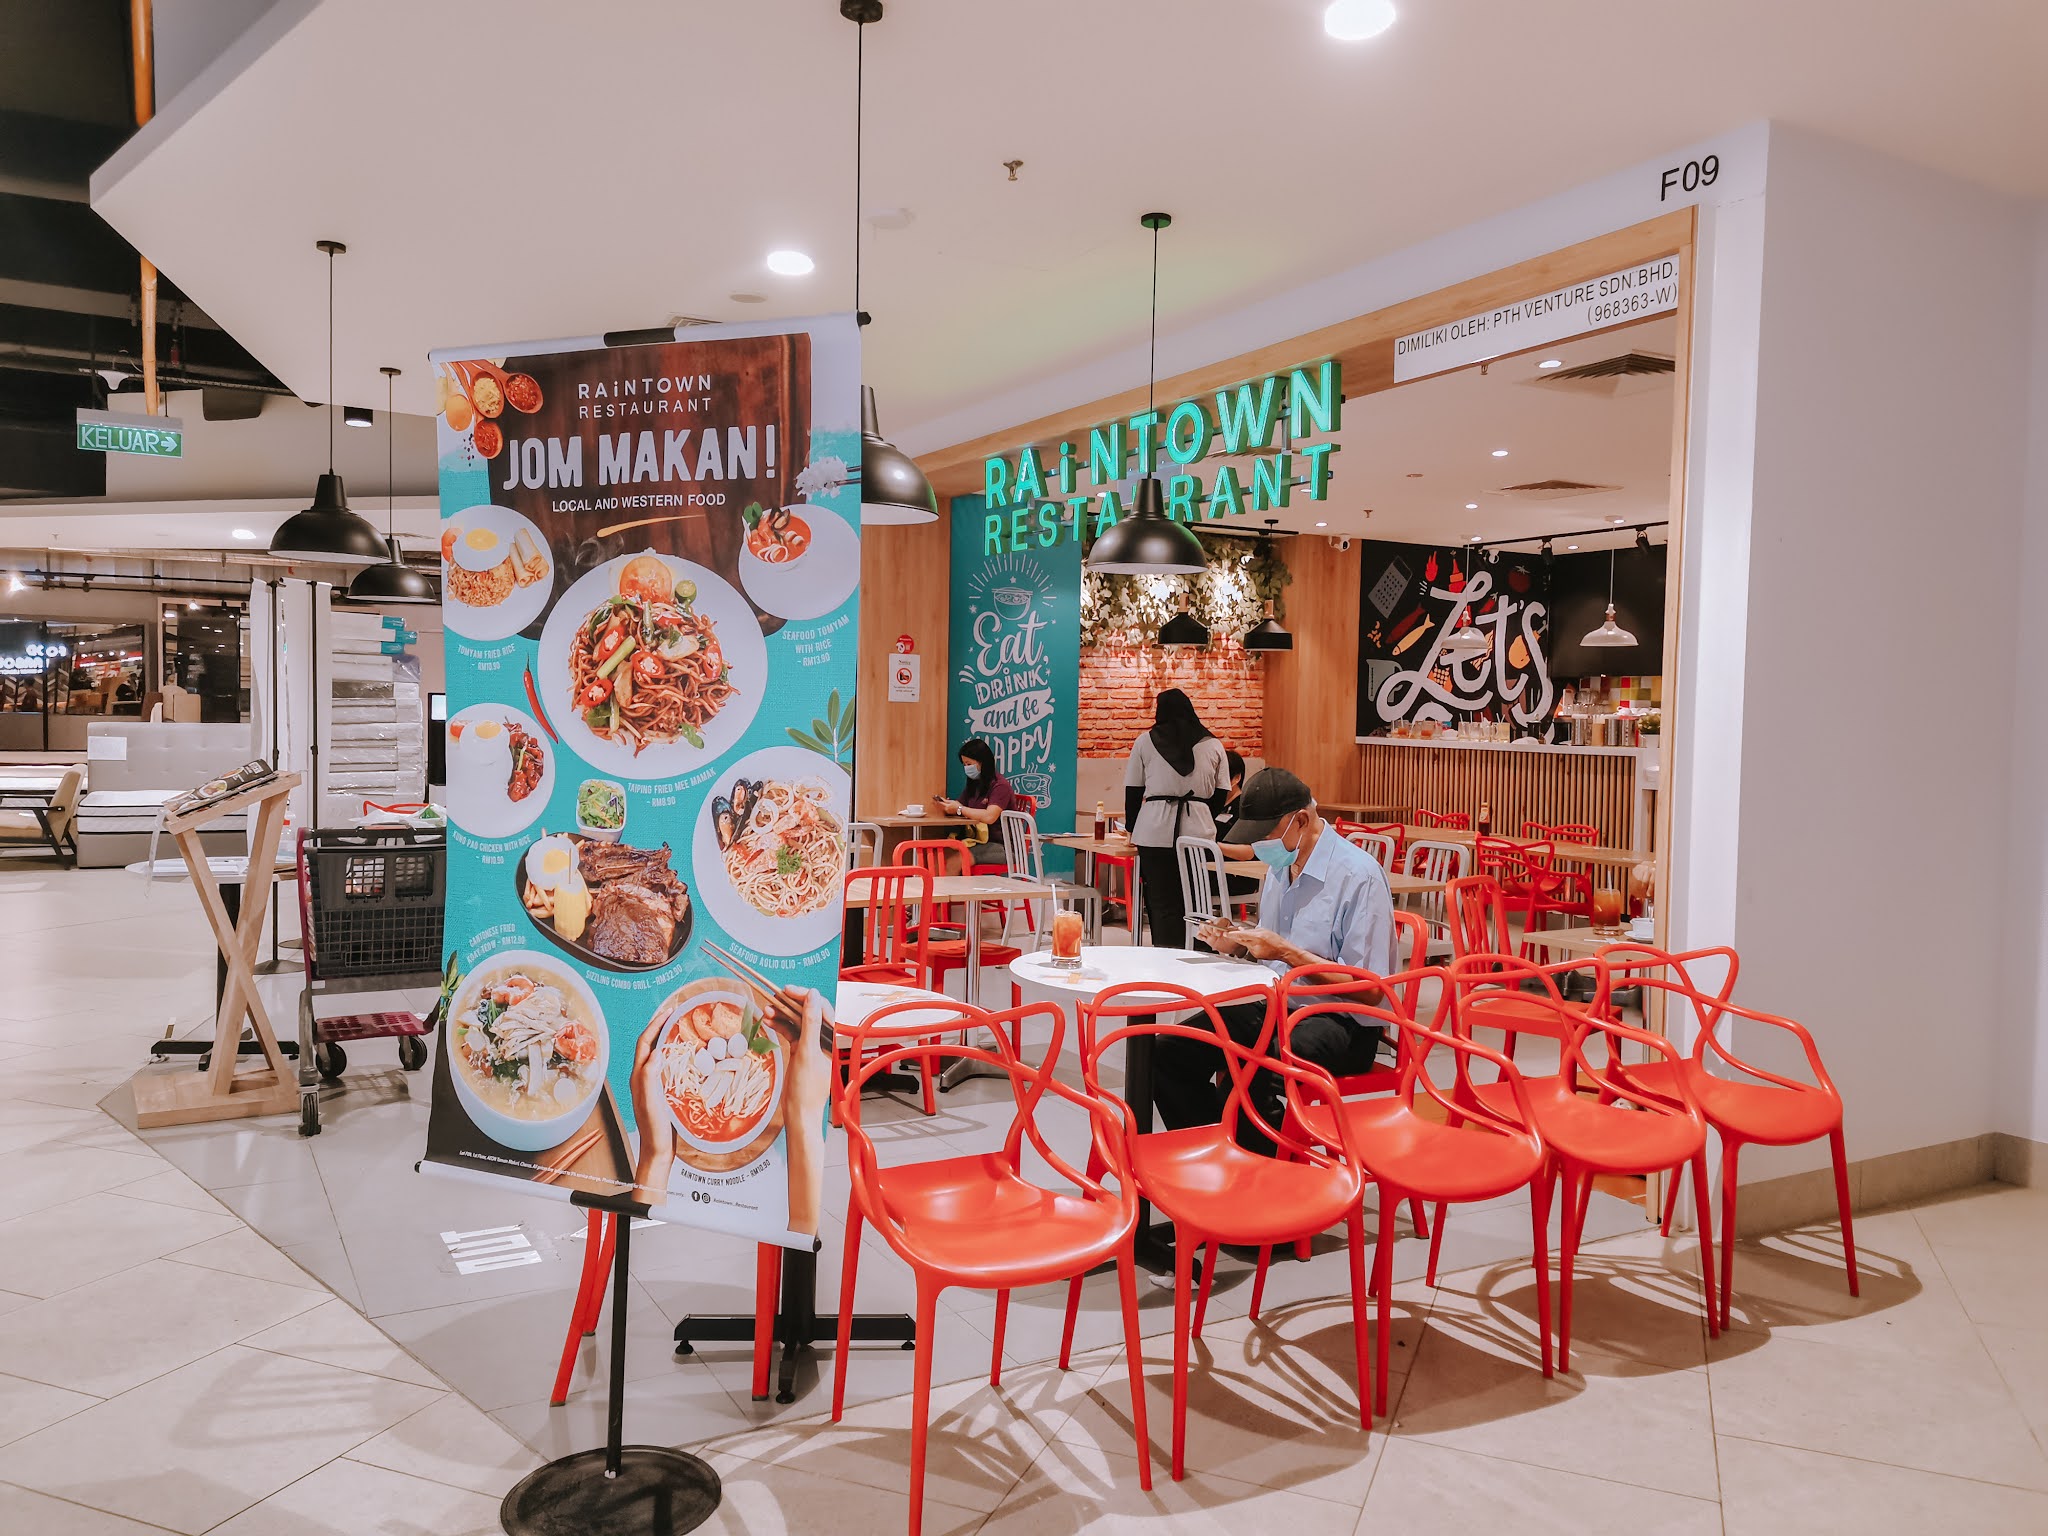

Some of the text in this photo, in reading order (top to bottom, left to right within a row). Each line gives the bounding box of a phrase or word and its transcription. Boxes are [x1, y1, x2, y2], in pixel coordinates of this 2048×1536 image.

[1661, 154, 1720, 202] F09
[1587, 283, 1678, 326] (968363-W)
[1397, 329, 1448, 356] DIMILIKI
[1450, 316, 1490, 341] OLEH:
[1493, 310, 1521, 330] PTH
[1524, 283, 1595, 319] VENTURE
[579, 397, 712, 420] RESTAURANT
[80, 425, 160, 455] KELUAR
[502, 424, 776, 491] JOM MAKAN!
[551, 493, 726, 513] LOCAL AND WESTERN FOOD
[984, 443, 1342, 556] RESTARANT
[782, 614, 850, 641] SEAFOOD TOMYAM
[457, 644, 483, 659] TOMYAM
[502, 642, 516, 656] RICE
[795, 638, 832, 654] WITH RICE
[802, 652, 831, 667] RM13.90
[984, 696, 1040, 730] and be
[627, 766, 717, 795] TAIPING FRIED MEE MAMAK
[479, 842, 503, 853] CHICKEN
[503, 840, 519, 852] WITH
[518, 833, 532, 847] RICE
[469, 923, 516, 948] CANTONESE FRIED
[729, 942, 759, 965] SEAFOOD
[780, 959, 797, 970] OLIO
[586, 969, 611, 986] SIZZLING
[610, 978, 633, 990] COMBO
[632, 980, 653, 990] GRILL
[681, 1168, 706, 1185] RAINTOWN
[706, 1177, 724, 1187] CURRY
[724, 1173, 746, 1187] NOODLE
